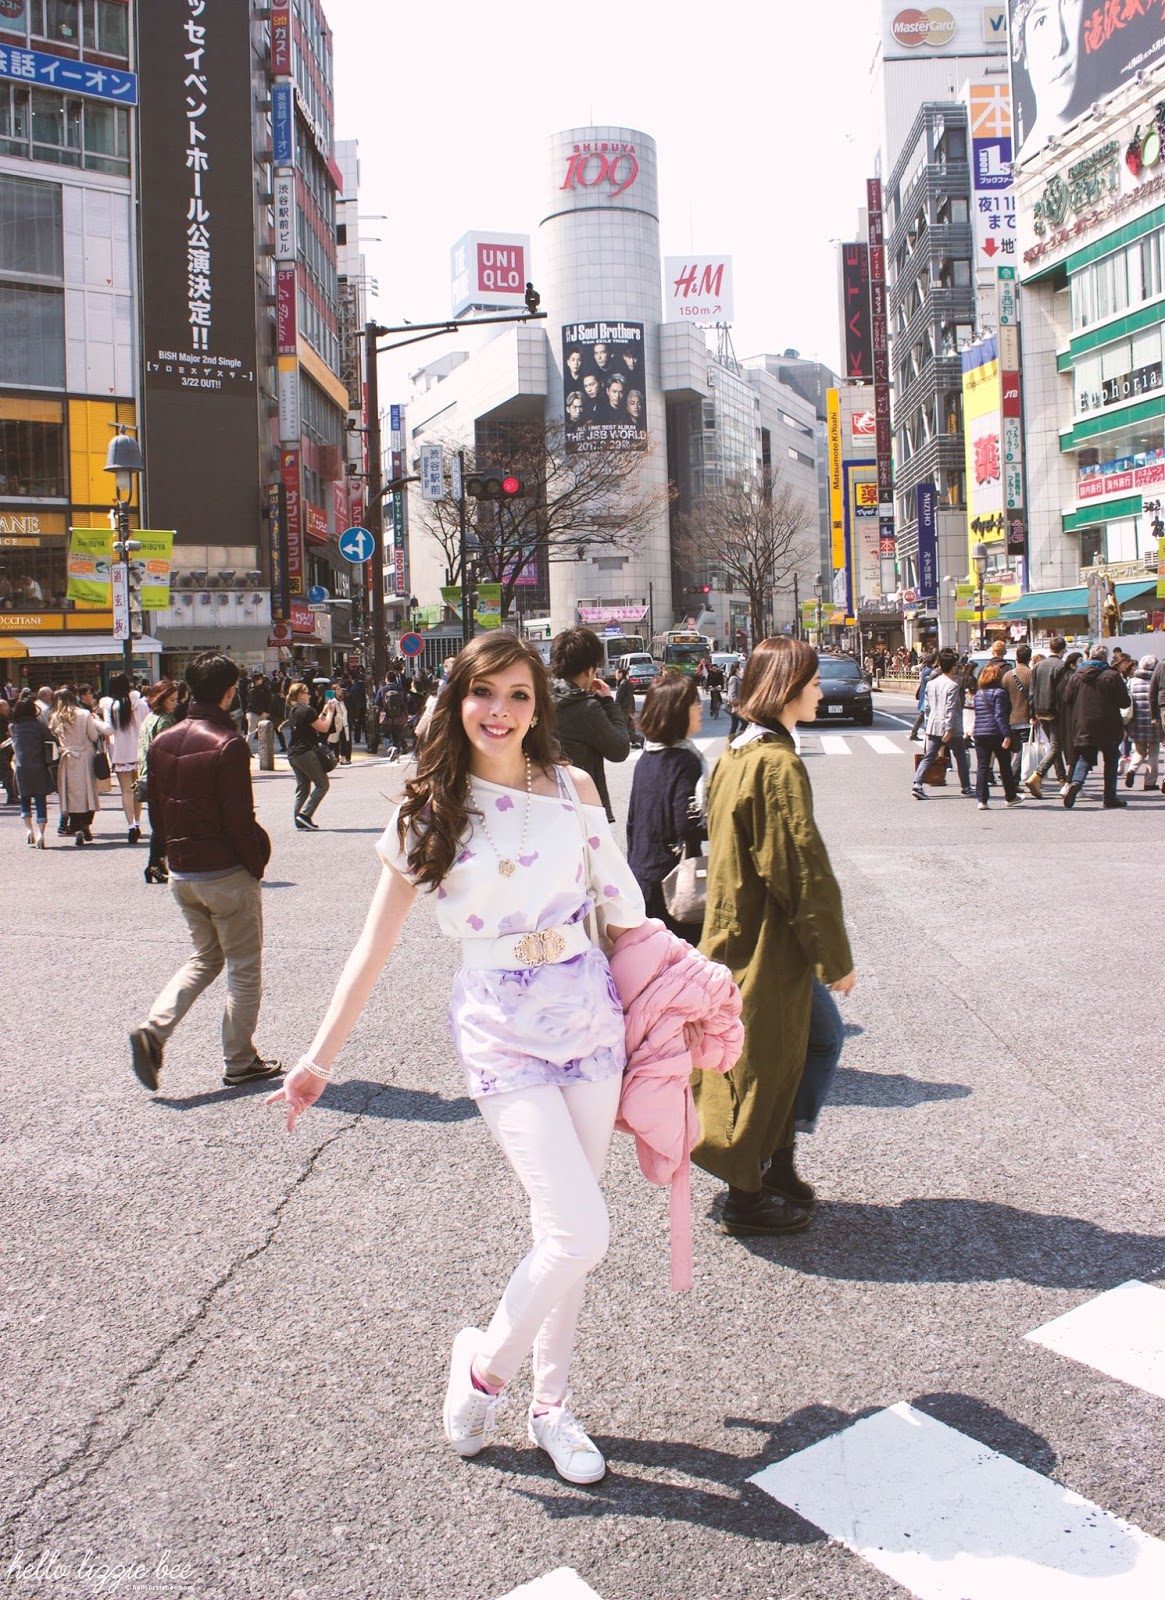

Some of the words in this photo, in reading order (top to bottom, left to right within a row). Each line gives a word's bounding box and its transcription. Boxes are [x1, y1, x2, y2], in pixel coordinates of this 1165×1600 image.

[893, 20, 954, 34] MasterCard
[275, 27, 287, 66] ガスト
[972, 85, 1012, 137] 本
[573, 143, 636, 154] SHIBUYA
[979, 150, 988, 175] BOOK
[559, 151, 639, 198] 109
[278, 184, 290, 253] 渋谷駅前ビル
[1001, 238, 1017, 254] 地
[482, 249, 516, 268] UNI
[278, 271, 294, 280] 5F
[483, 269, 520, 289] QLO
[673, 263, 724, 298] H&M
[680, 306, 710, 316] 150m
[579, 322, 598, 341] Soul
[600, 322, 641, 341] Brothers
[179, 353, 201, 364] Major
[202, 355, 217, 365] 2nd
[218, 357, 242, 369] Single
[181, 377, 199, 387] 3/22
[200, 379, 221, 389] OUT!!
[1003, 389, 1019, 399] JTB
[566, 431, 585, 441] THE
[587, 430, 608, 440] JSB
[610, 429, 647, 440] WORLD
[831, 444, 839, 490] Matsumoto
[973, 434, 1000, 486] 薬
[430, 449, 441, 495] 渋谷駅前
[1107, 475, 1131, 493] 海外旅行
[923, 492, 931, 527] MIZUHO
[0, 538, 18, 546] CE
[141, 543, 166, 551] HIBUYA
[396, 551, 405, 592] HOOTERS
[924, 551, 932, 588] みずほ銀行
[113, 570, 124, 633] 道玄坂
